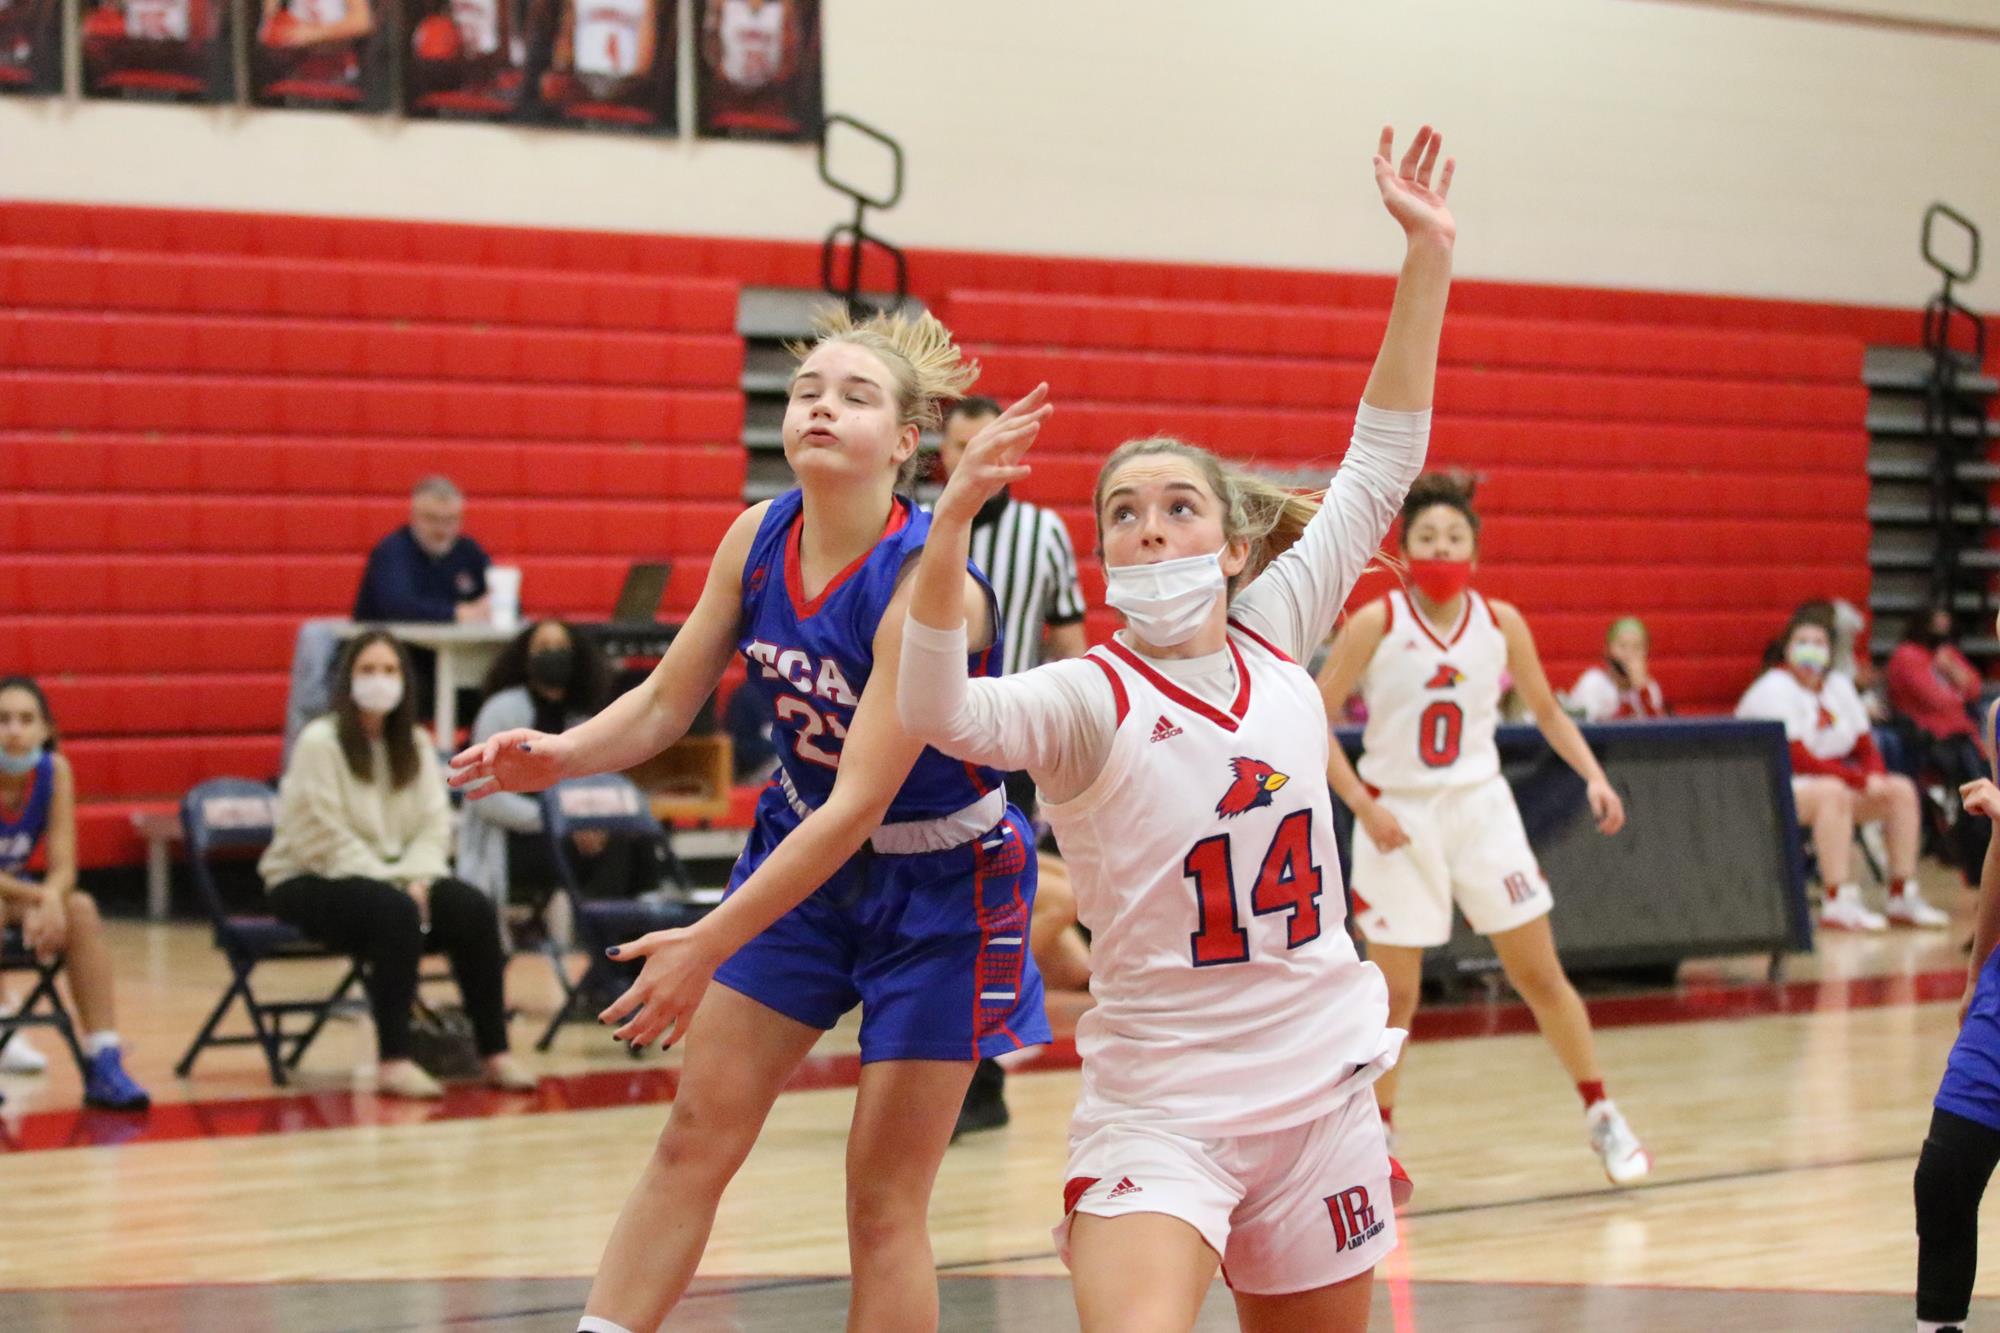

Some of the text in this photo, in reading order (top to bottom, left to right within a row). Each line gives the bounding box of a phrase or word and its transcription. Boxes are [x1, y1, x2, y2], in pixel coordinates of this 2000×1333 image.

[1150, 727, 1183, 743] adidas
[1419, 699, 1463, 768] 0
[1184, 808, 1323, 968] 14
[1347, 1233, 1366, 1251] LADY
